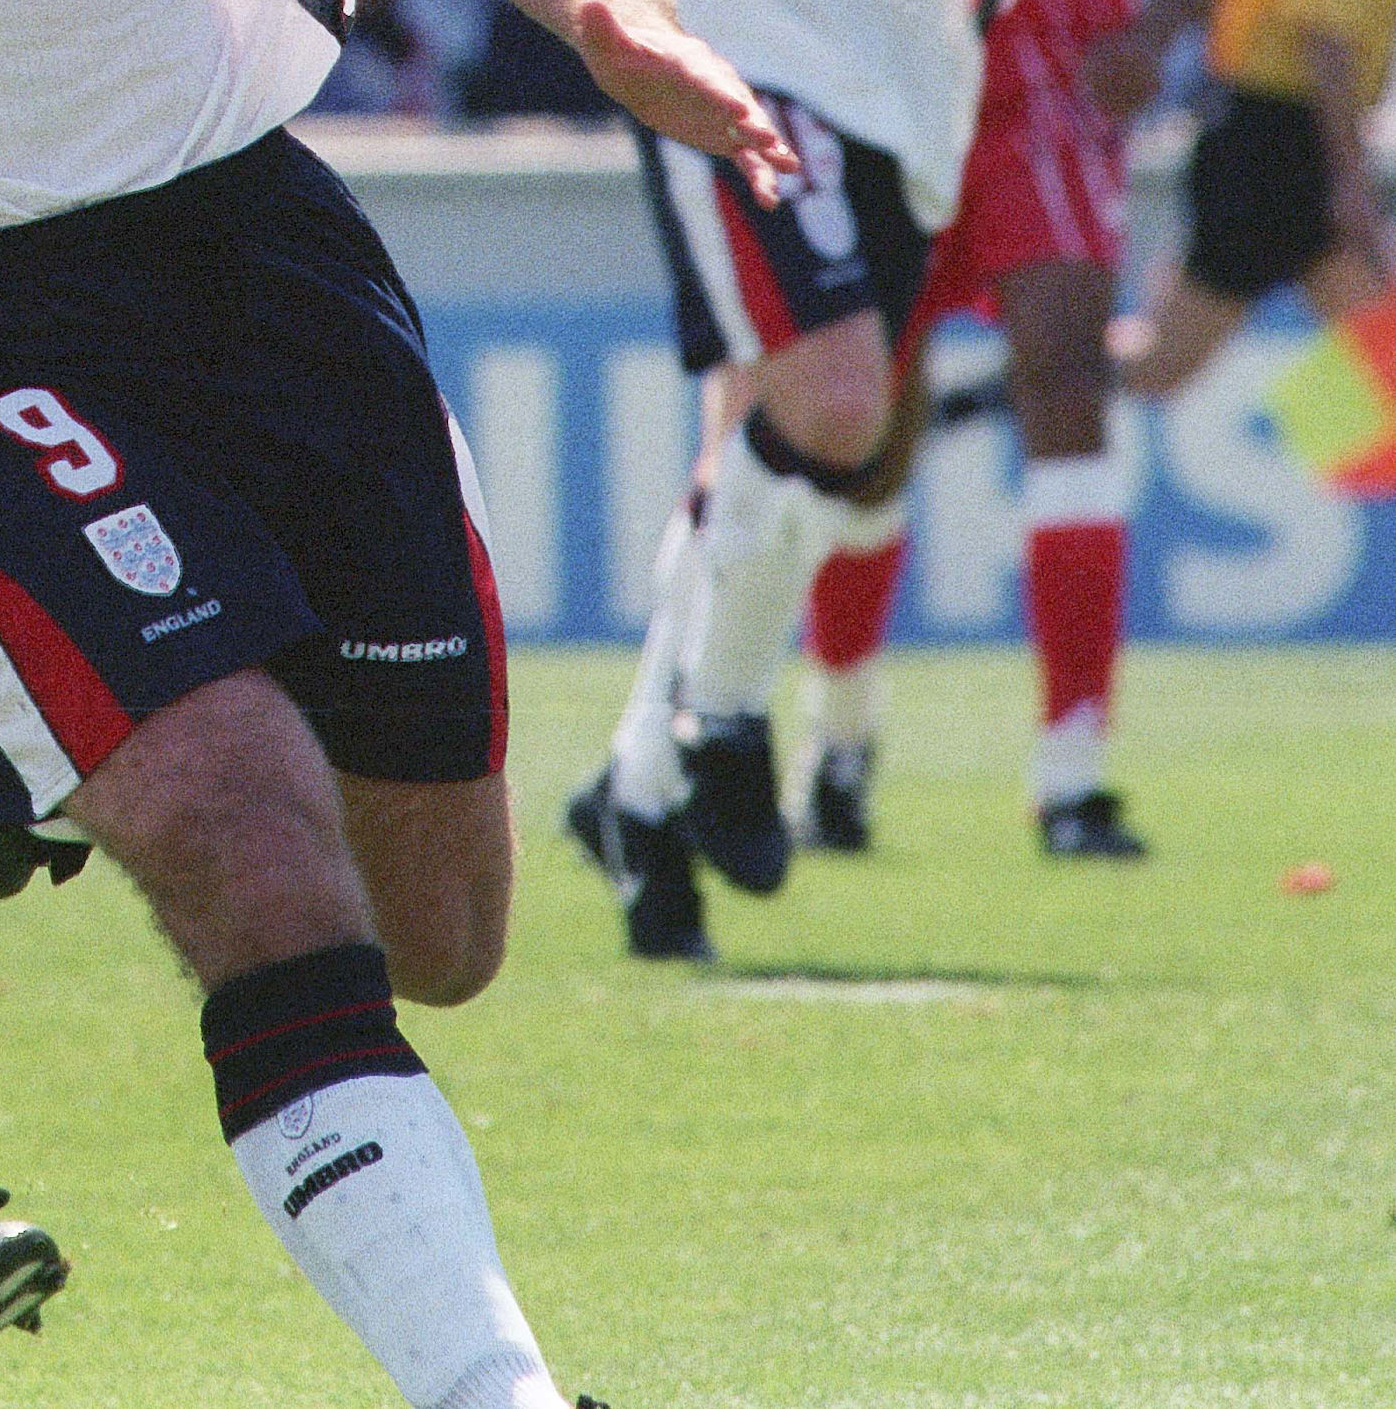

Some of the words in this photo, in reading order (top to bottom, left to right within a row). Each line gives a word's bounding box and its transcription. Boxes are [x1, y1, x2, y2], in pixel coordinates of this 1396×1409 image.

[141, 598, 222, 644] ENGLAND
[339, 636, 467, 664] UMBRO
[285, 1132, 341, 1176] ENGLAND
[283, 1141, 384, 1220] UMBRO
